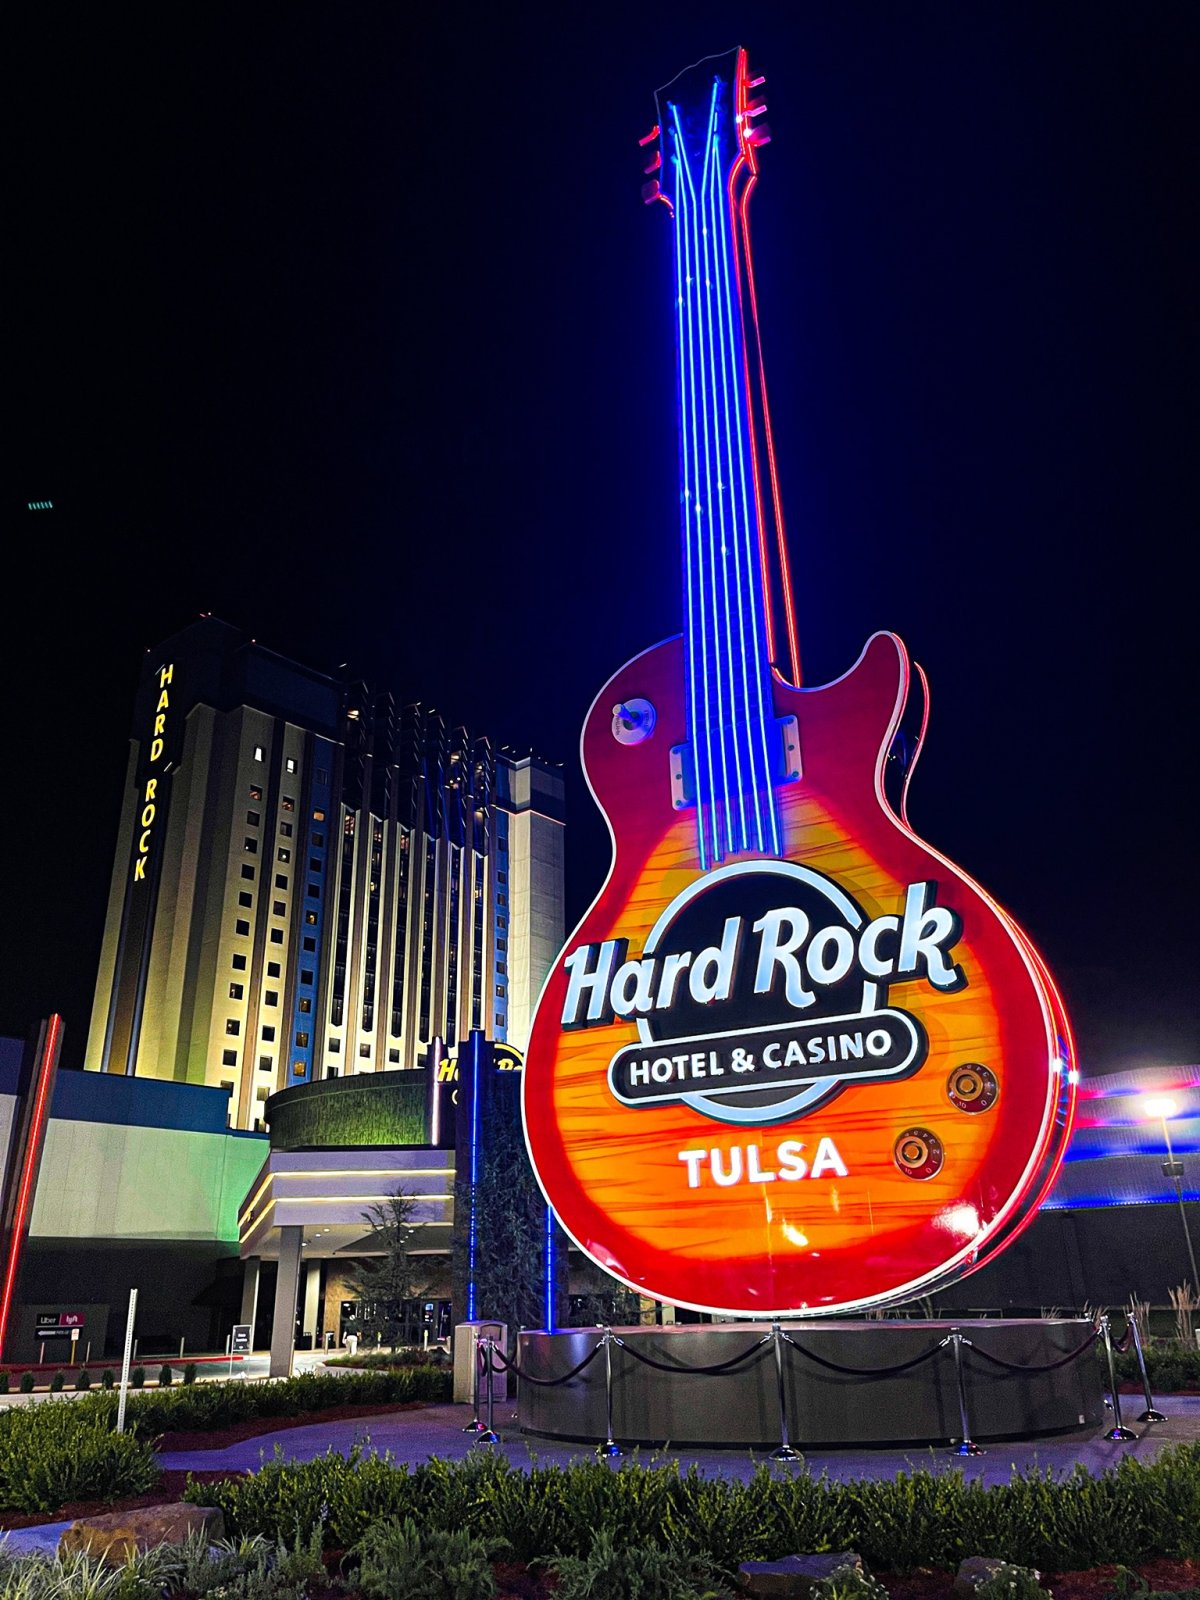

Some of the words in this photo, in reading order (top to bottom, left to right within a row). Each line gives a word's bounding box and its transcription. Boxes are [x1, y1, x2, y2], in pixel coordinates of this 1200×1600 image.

[151, 663, 174, 762] HARD
[134, 778, 157, 882] ROCK
[561, 916, 744, 1026] Hard
[753, 881, 962, 1009] Rock
[629, 1051, 724, 1086] HOTEL
[731, 1047, 755, 1073] &
[762, 1029, 892, 1069] CASINO
[678, 1138, 848, 1188] TULSA
